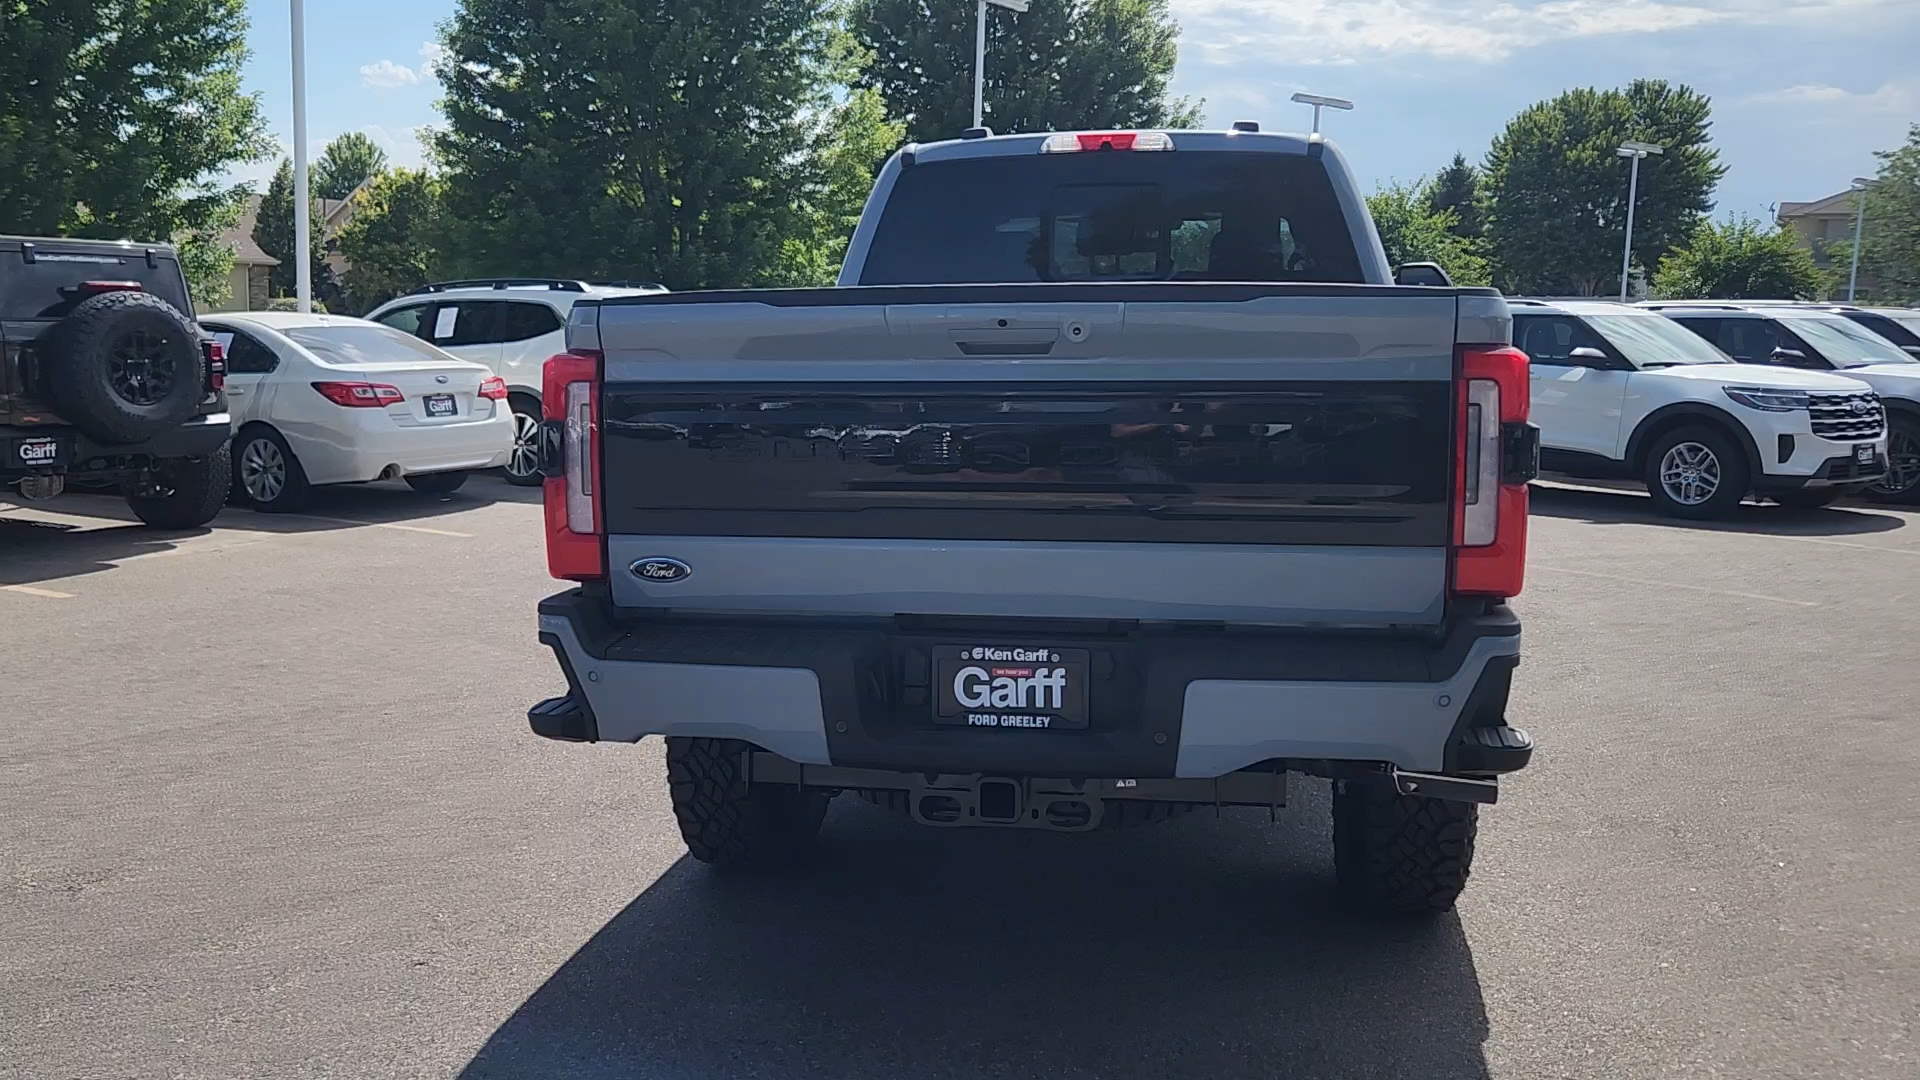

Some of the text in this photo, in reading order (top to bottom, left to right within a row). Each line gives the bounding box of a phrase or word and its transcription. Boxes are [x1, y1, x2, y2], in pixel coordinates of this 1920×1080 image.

[19, 443, 57, 459] Garff
[643, 563, 676, 577] Ford
[985, 648, 1049, 662] Ken Garff
[953, 666, 1066, 709] Garff
[968, 714, 1051, 728] FORD GREELEY
